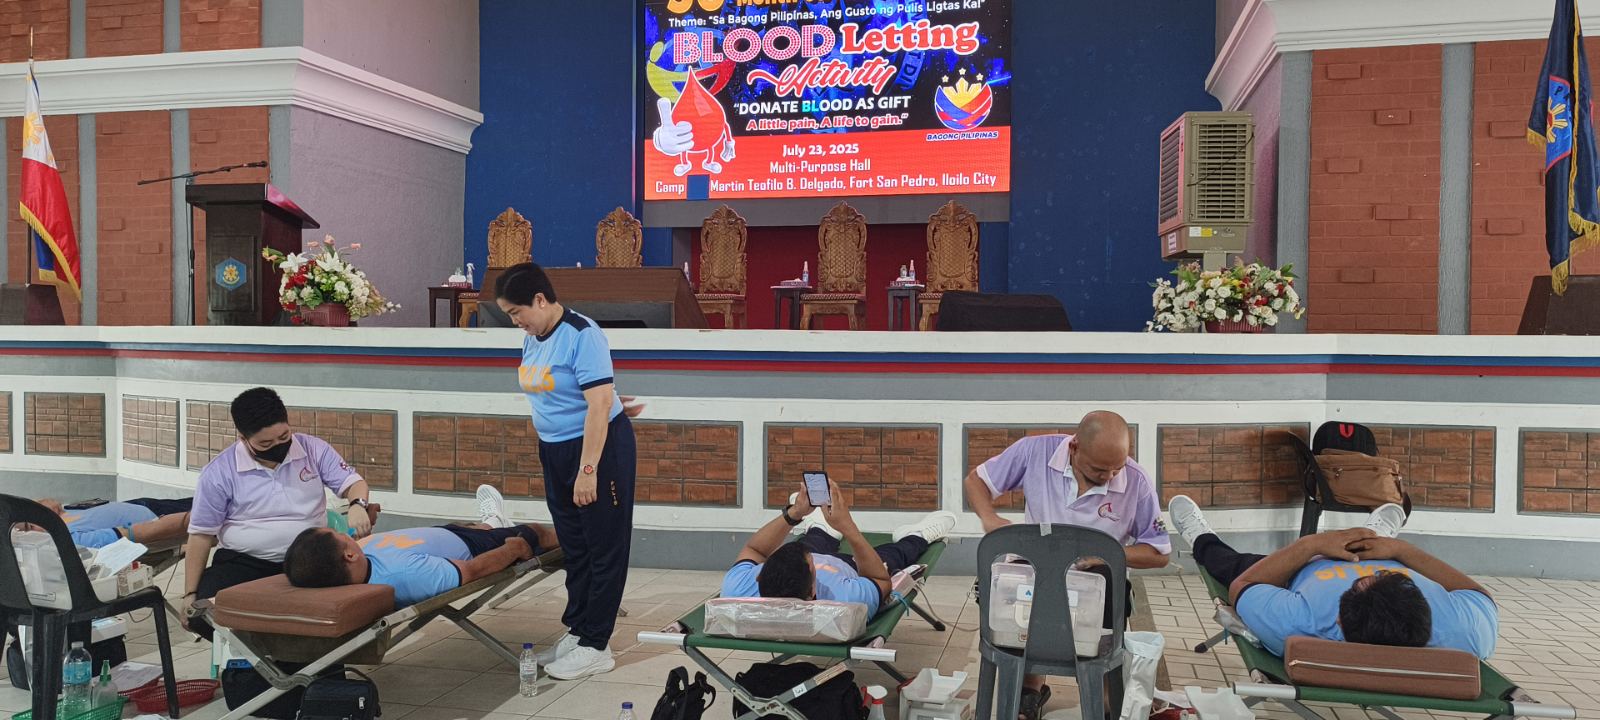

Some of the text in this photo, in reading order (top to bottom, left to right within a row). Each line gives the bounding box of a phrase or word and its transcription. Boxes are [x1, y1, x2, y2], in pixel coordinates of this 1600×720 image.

[669, 18, 707, 28] Theme:
[728, 14, 767, 26] Bagong
[770, 10, 818, 23] Pilipinas,
[820, 9, 842, 19] Ang
[845, 6, 877, 17] Gusto
[880, 6, 894, 16] ng
[897, 2, 923, 13] Pulis
[926, 1, 960, 14] Ligtas
[673, 18, 980, 64] BLOOD Letting
[746, 55, 898, 98] Activity
[733, 95, 911, 115] "DONATE BLOOD AS GIFT
[745, 119, 757, 131] A
[759, 118, 788, 130] little
[788, 117, 820, 132] pain,
[820, 116, 832, 128] A
[832, 115, 853, 127] life
[855, 115, 869, 126] to
[926, 131, 998, 141] BAGONG PILIPINAS
[782, 143, 859, 157] July 23, 2025
[770, 158, 871, 175] Multi-Purpose Hall
[655, 171, 997, 195] Camp Martin Teofilo B. Delgado, Fort San Pedro, Iloilo City
